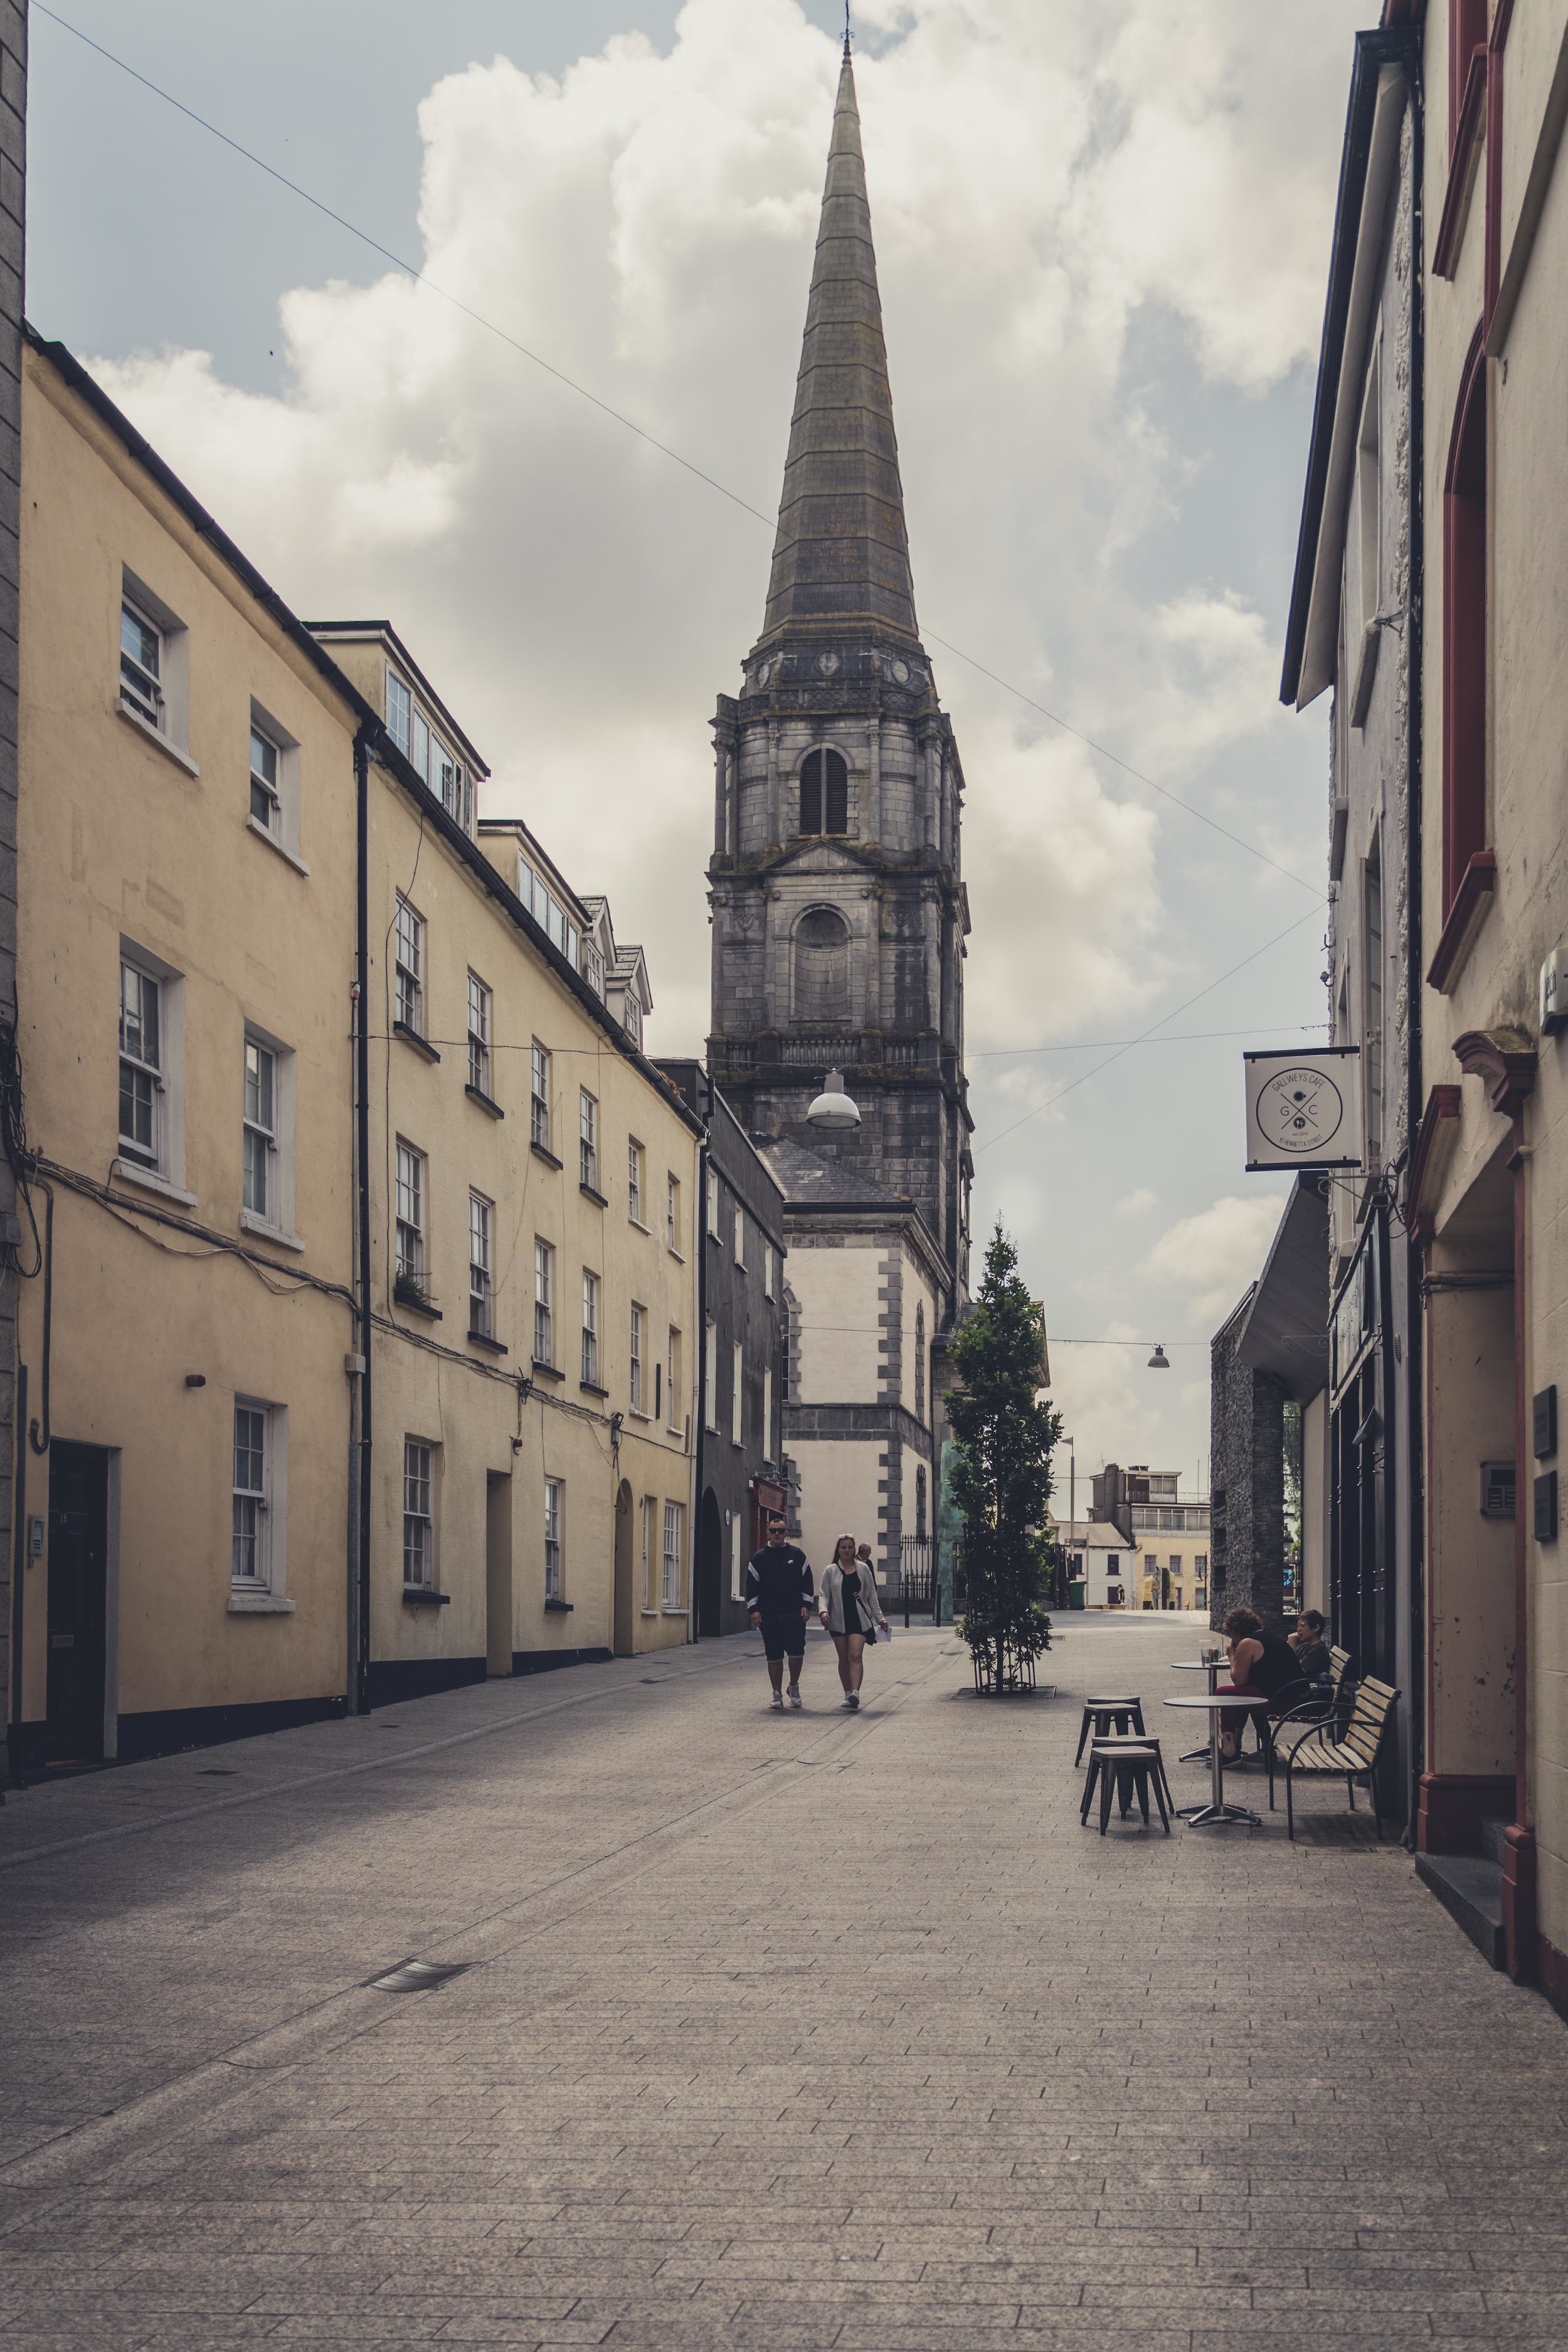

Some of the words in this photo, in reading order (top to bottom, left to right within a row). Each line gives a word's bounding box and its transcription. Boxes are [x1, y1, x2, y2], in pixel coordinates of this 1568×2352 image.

[1272, 1073, 1308, 1091] GALLWEYS
[1308, 1075, 1325, 1089] CAFE
[1280, 1106, 1290, 1116] G
[1308, 1104, 1318, 1115] C
[1285, 1139, 1307, 1147] HENRIETTA
[1307, 1134, 1323, 1146] STREET
